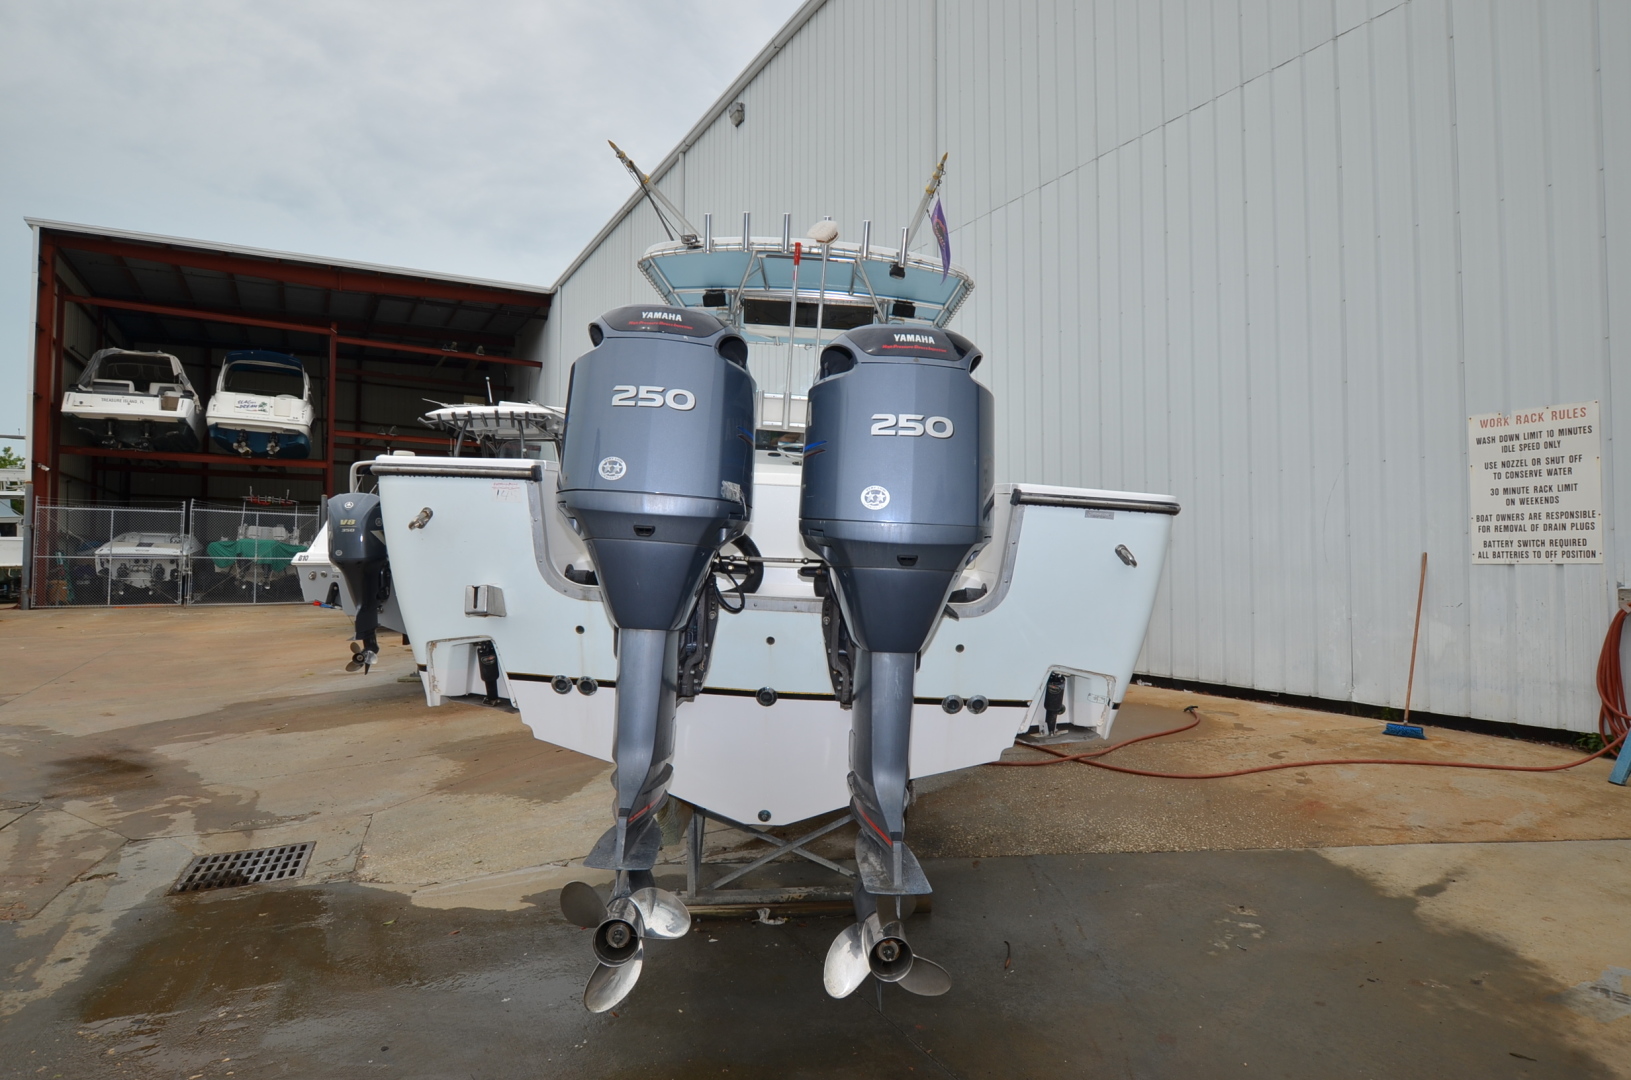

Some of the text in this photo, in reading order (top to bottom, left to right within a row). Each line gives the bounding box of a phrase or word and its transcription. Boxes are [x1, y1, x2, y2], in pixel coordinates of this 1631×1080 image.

[642, 312, 682, 321] YAMAHA
[894, 334, 935, 344] YAMAHA
[611, 384, 696, 411] 250
[1480, 407, 1587, 428] WORK RACK RULES
[870, 413, 954, 438] 250
[1476, 425, 1592, 445] WASH DOWN LIMIT 10 MINUTES
[1502, 440, 1561, 453] IDLE SPEED ONLY
[1501, 459, 1528, 468] NOZZEL
[1532, 458, 1541, 466] OR
[1545, 456, 1565, 465] SHUT
[1569, 454, 1582, 463] OFF
[1505, 469, 1542, 479] CONSERVE
[1547, 467, 1572, 476] WATER
[1503, 486, 1530, 495] MINUTE
[1534, 485, 1553, 494] RACK
[1557, 483, 1578, 492] LIMIT
[1519, 496, 1559, 505] WEEKENDS
[1496, 513, 1525, 522] OWNERS
[1528, 512, 1542, 520] ARE
[1546, 510, 1596, 520] RESPONSIBLE
[1494, 524, 1527, 533] REMOVAL
[1543, 523, 1566, 531] DRAIN
[1571, 522, 1595, 531] PLUGS
[1483, 538, 1587, 548] BATTERY SWITCH REQUIRED
[1545, 550, 1557, 558] OFF
[1562, 550, 1596, 558] POSITION
